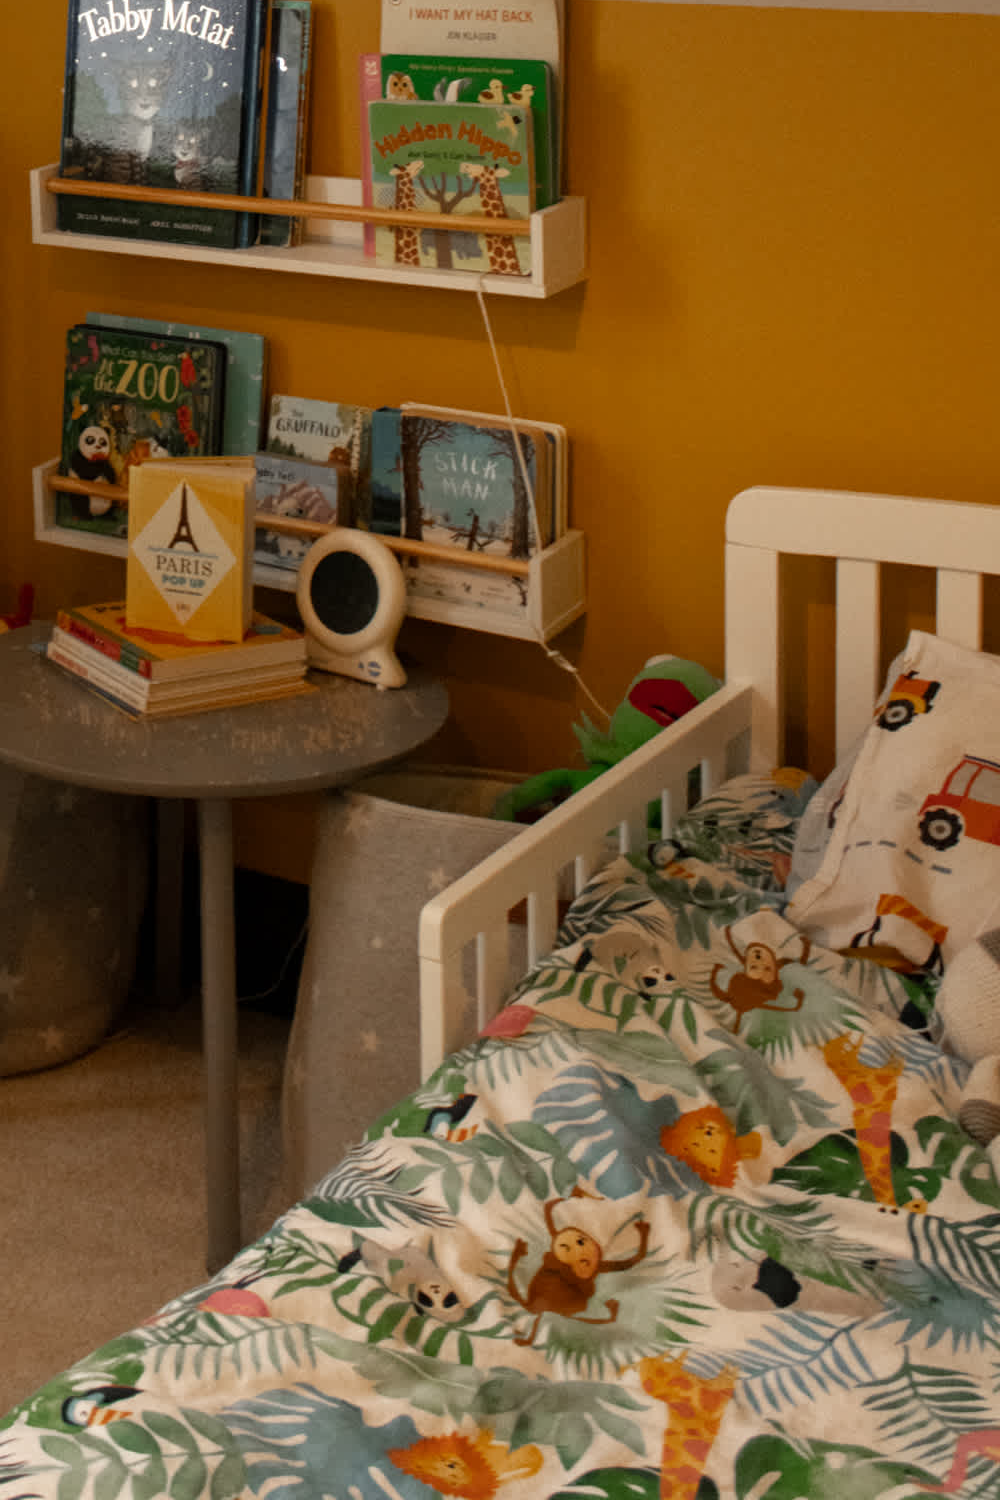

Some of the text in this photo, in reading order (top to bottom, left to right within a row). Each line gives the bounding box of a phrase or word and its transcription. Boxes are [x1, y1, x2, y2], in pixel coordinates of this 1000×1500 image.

[408, 7, 534, 23] I WANT MY HAT BACK
[374, 119, 522, 166] Hidden Hippo
[115, 359, 180, 403] ZOO
[275, 417, 341, 438] GRUFFALO
[434, 452, 499, 481] STICK
[441, 477, 489, 501] MAN
[156, 555, 213, 578] PARIS
[161, 574, 206, 589] POP UP
